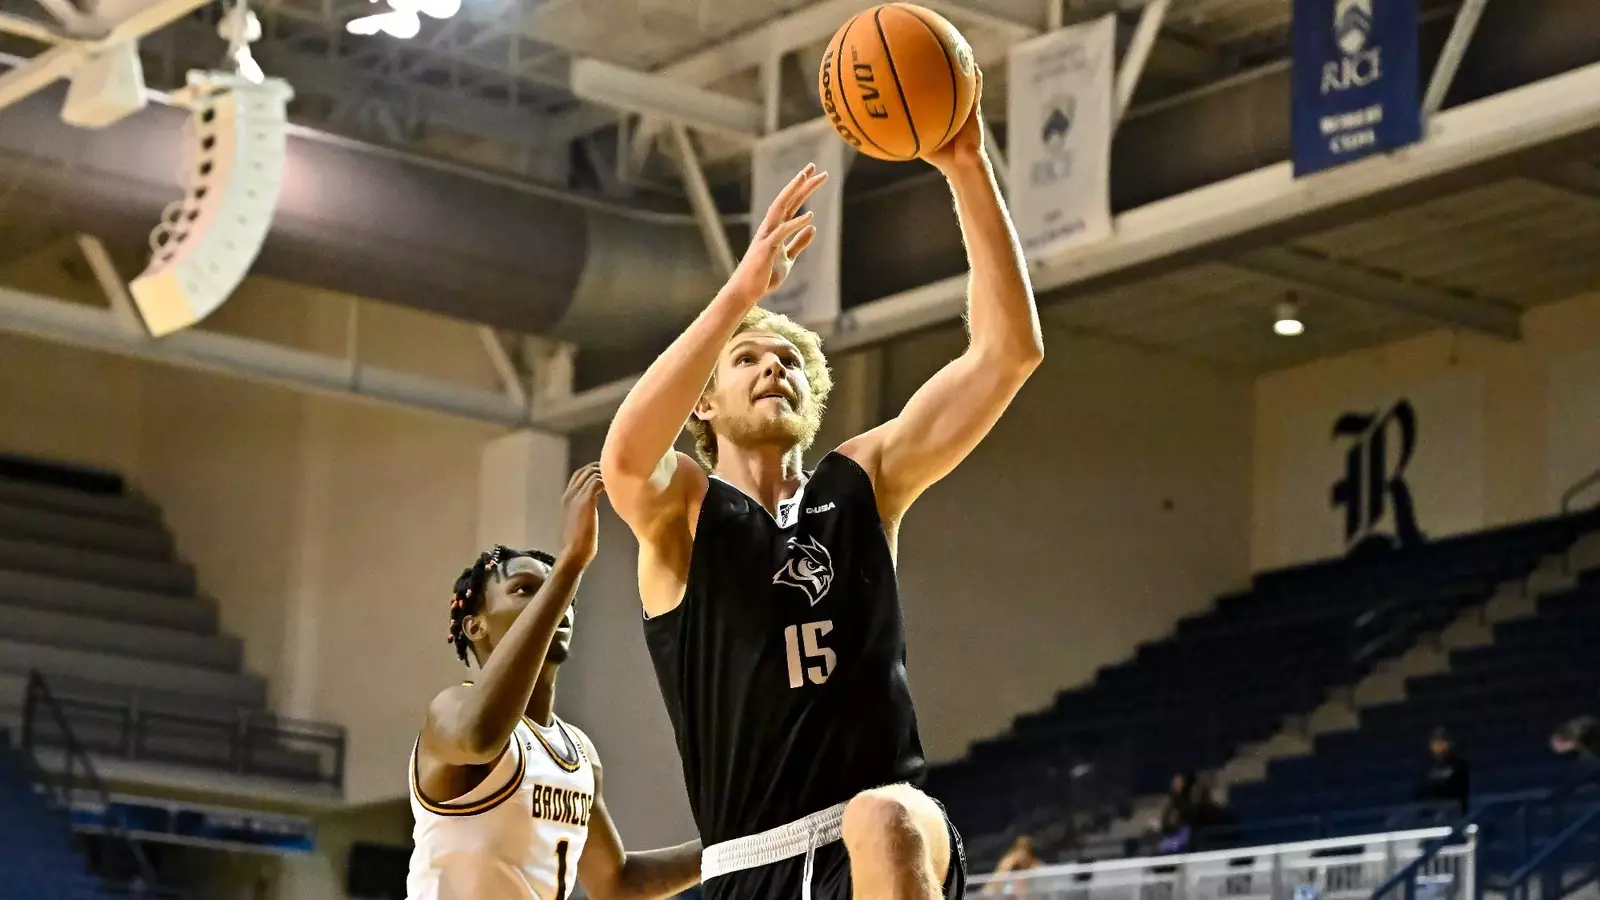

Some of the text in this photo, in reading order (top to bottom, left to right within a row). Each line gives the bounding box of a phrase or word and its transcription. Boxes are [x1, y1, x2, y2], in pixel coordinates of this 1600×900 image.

[853, 63, 888, 120] EVO
[784, 619, 837, 688] 15
[556, 839, 569, 900] 1
